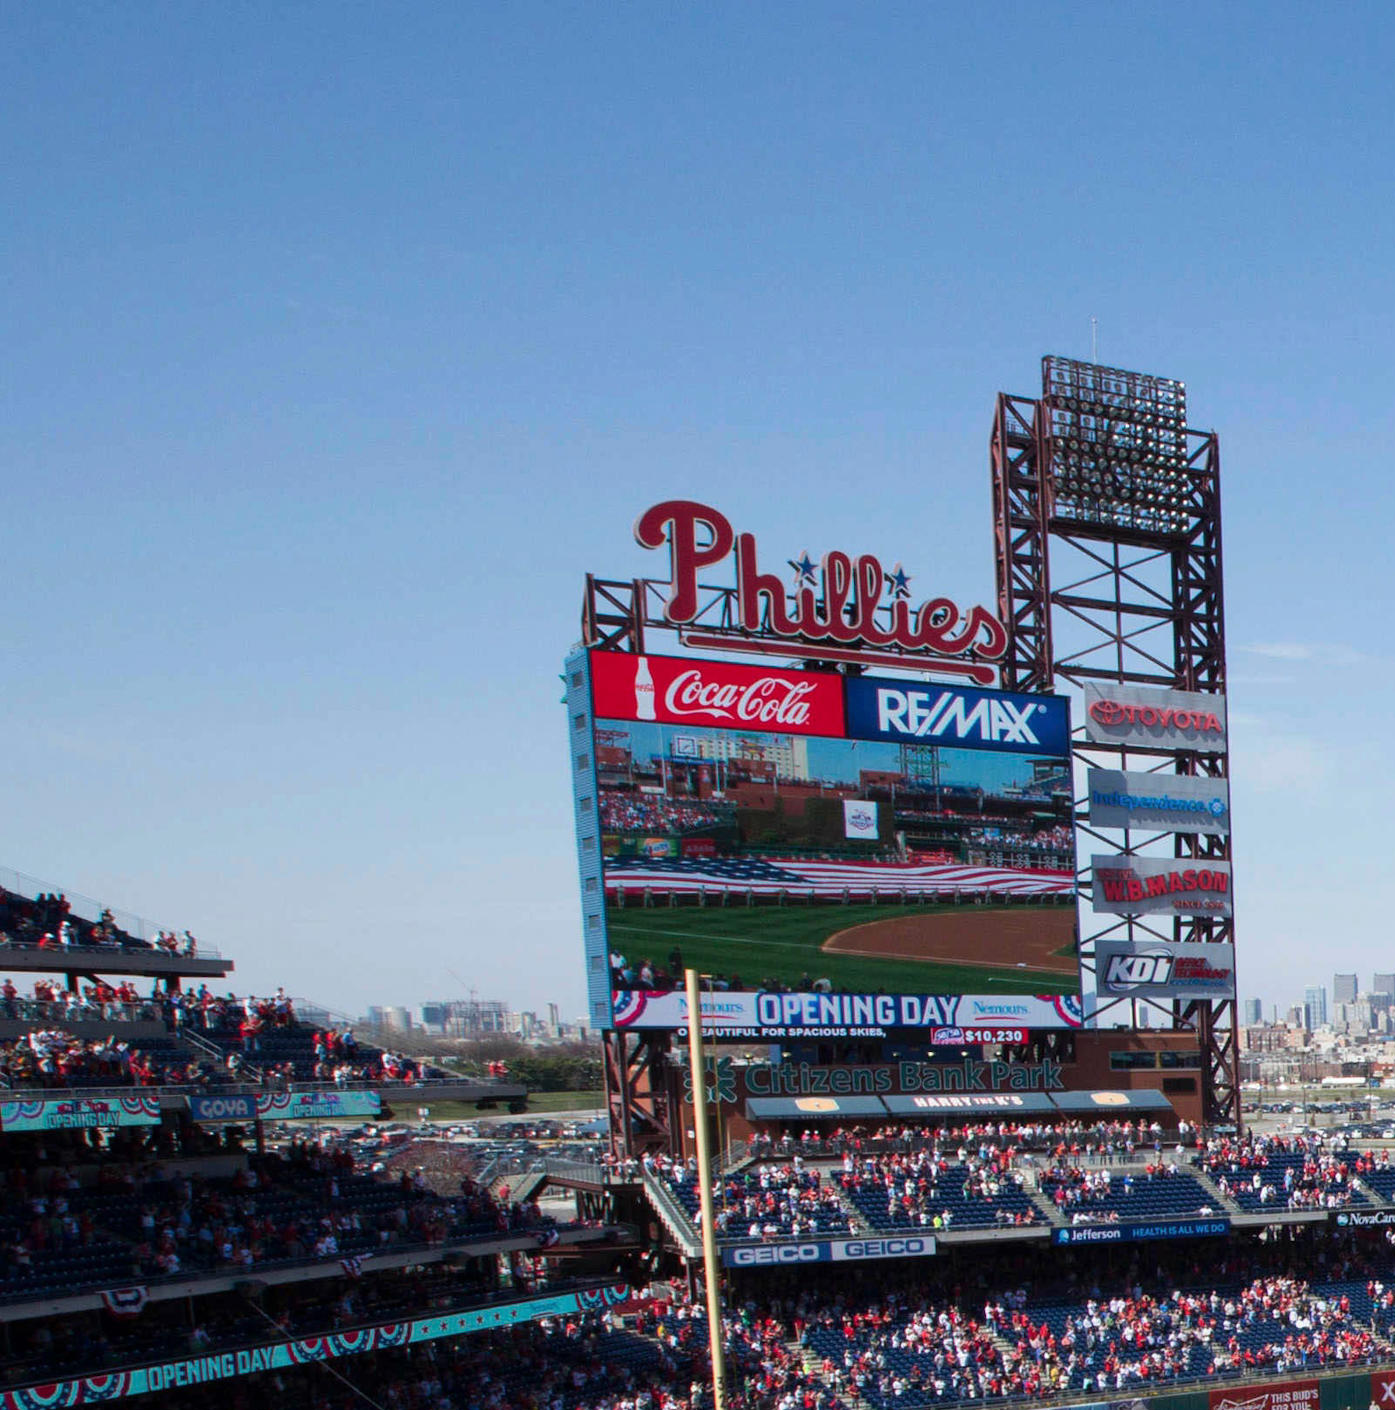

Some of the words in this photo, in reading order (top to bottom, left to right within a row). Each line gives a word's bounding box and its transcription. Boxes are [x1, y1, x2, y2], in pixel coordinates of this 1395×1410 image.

[634, 500, 1007, 661] Phillies
[665, 670, 817, 725] Coca-Cola
[878, 688, 1038, 744] RE/MAX
[1124, 705, 1222, 732] TOYOTA
[1093, 790, 1204, 811] Independence
[678, 998, 743, 1013] Nmours
[758, 993, 894, 1026] OPENING
[901, 995, 959, 1026] DAY
[973, 1000, 1029, 1015] Nemours
[699, 1028, 758, 1037] EAUTIFUL
[763, 1028, 786, 1037] FOR
[789, 1028, 847, 1037] SPACIOUS
[849, 1028, 887, 1038] SKIES,
[965, 1030, 1023, 1044] $10,230
[746, 1062, 892, 1094] Citizens
[899, 1060, 988, 1091] Bank
[991, 1058, 1064, 1089] Park
[200, 1100, 248, 1117] GOYA
[293, 1101, 329, 1117] OPENING
[914, 1096, 972, 1107] HARRY
[48, 1112, 97, 1129] OPENING
[99, 1110, 121, 1127] DAY
[1071, 1228, 1121, 1243] Jefferson
[1133, 1227, 1168, 1238] HEALTH
[1169, 1227, 1177, 1237] IS
[1179, 1226, 1196, 1237] ALL
[1197, 1225, 1212, 1236] WE
[1212, 1224, 1225, 1234] DO
[734, 1245, 819, 1265] GEICO
[845, 1237, 924, 1257] GEICO
[149, 1350, 235, 1391] OPENING
[238, 1346, 274, 1375] DAY
[1271, 1393, 1289, 1402] THIS
[1292, 1389, 1318, 1401] BUD'S
